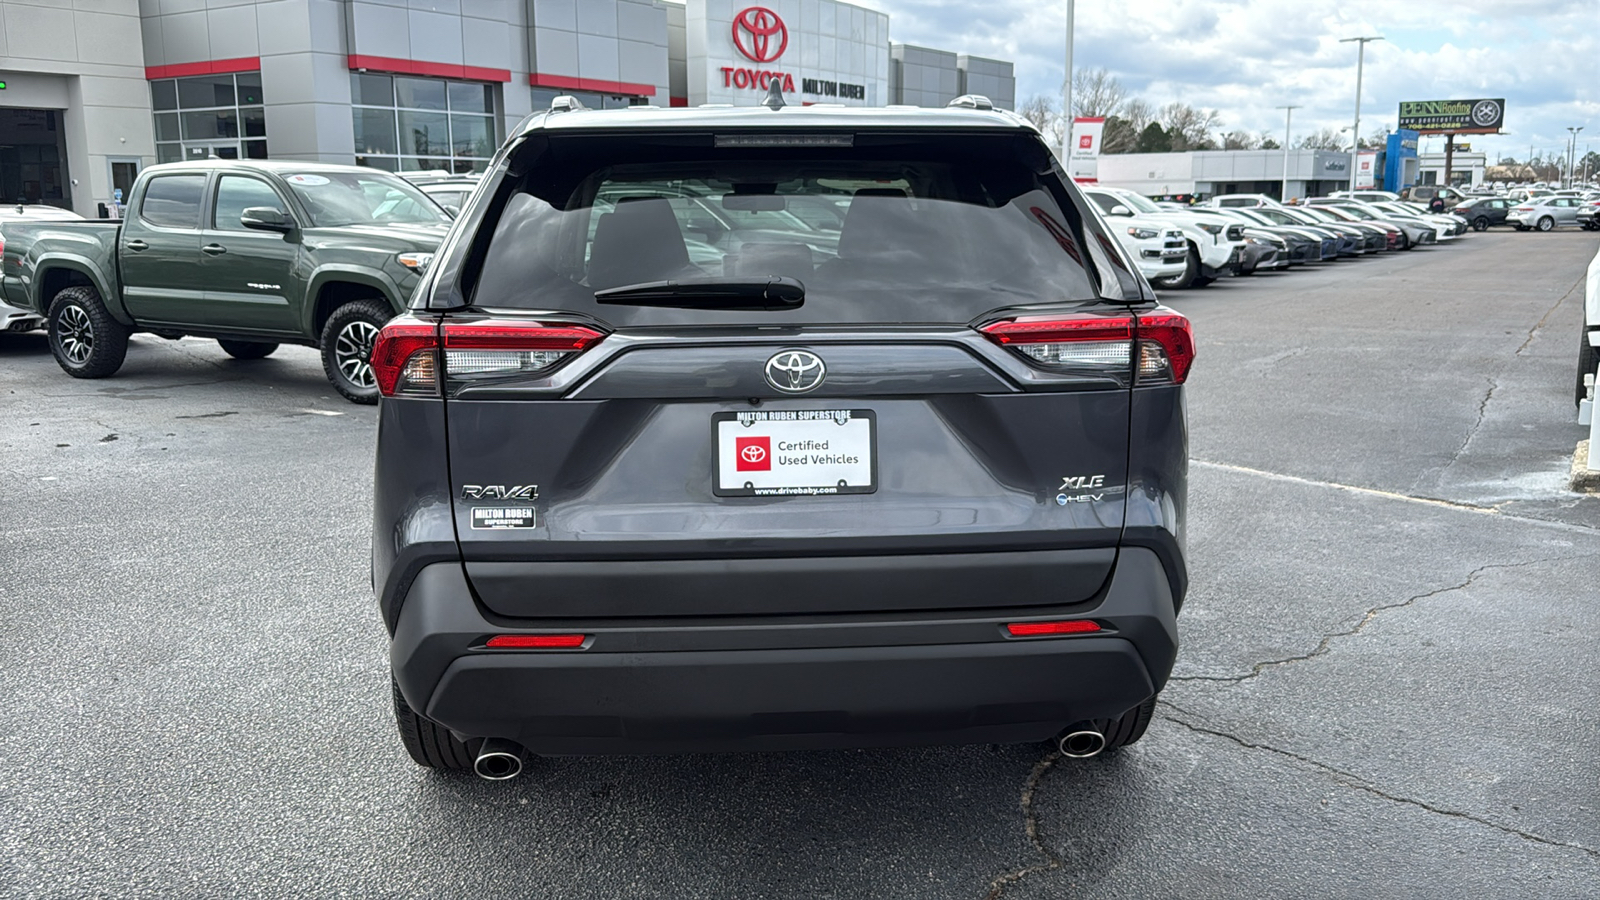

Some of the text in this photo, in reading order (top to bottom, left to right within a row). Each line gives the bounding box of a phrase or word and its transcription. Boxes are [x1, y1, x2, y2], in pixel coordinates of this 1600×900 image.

[802, 78, 865, 100] MILTON RUBEN
[1443, 101, 1471, 115] Roofing
[737, 410, 851, 421] MILTON RUBEN SUPERSTORE
[778, 440, 829, 451] Certified
[778, 454, 859, 466] Used Vehicles
[1058, 474, 1105, 490] XLE
[461, 484, 539, 501] RAV4
[755, 486, 837, 496] www.drivebaby.com
[1067, 493, 1104, 503] HEV
[475, 508, 533, 519] MILTON RUBEN
